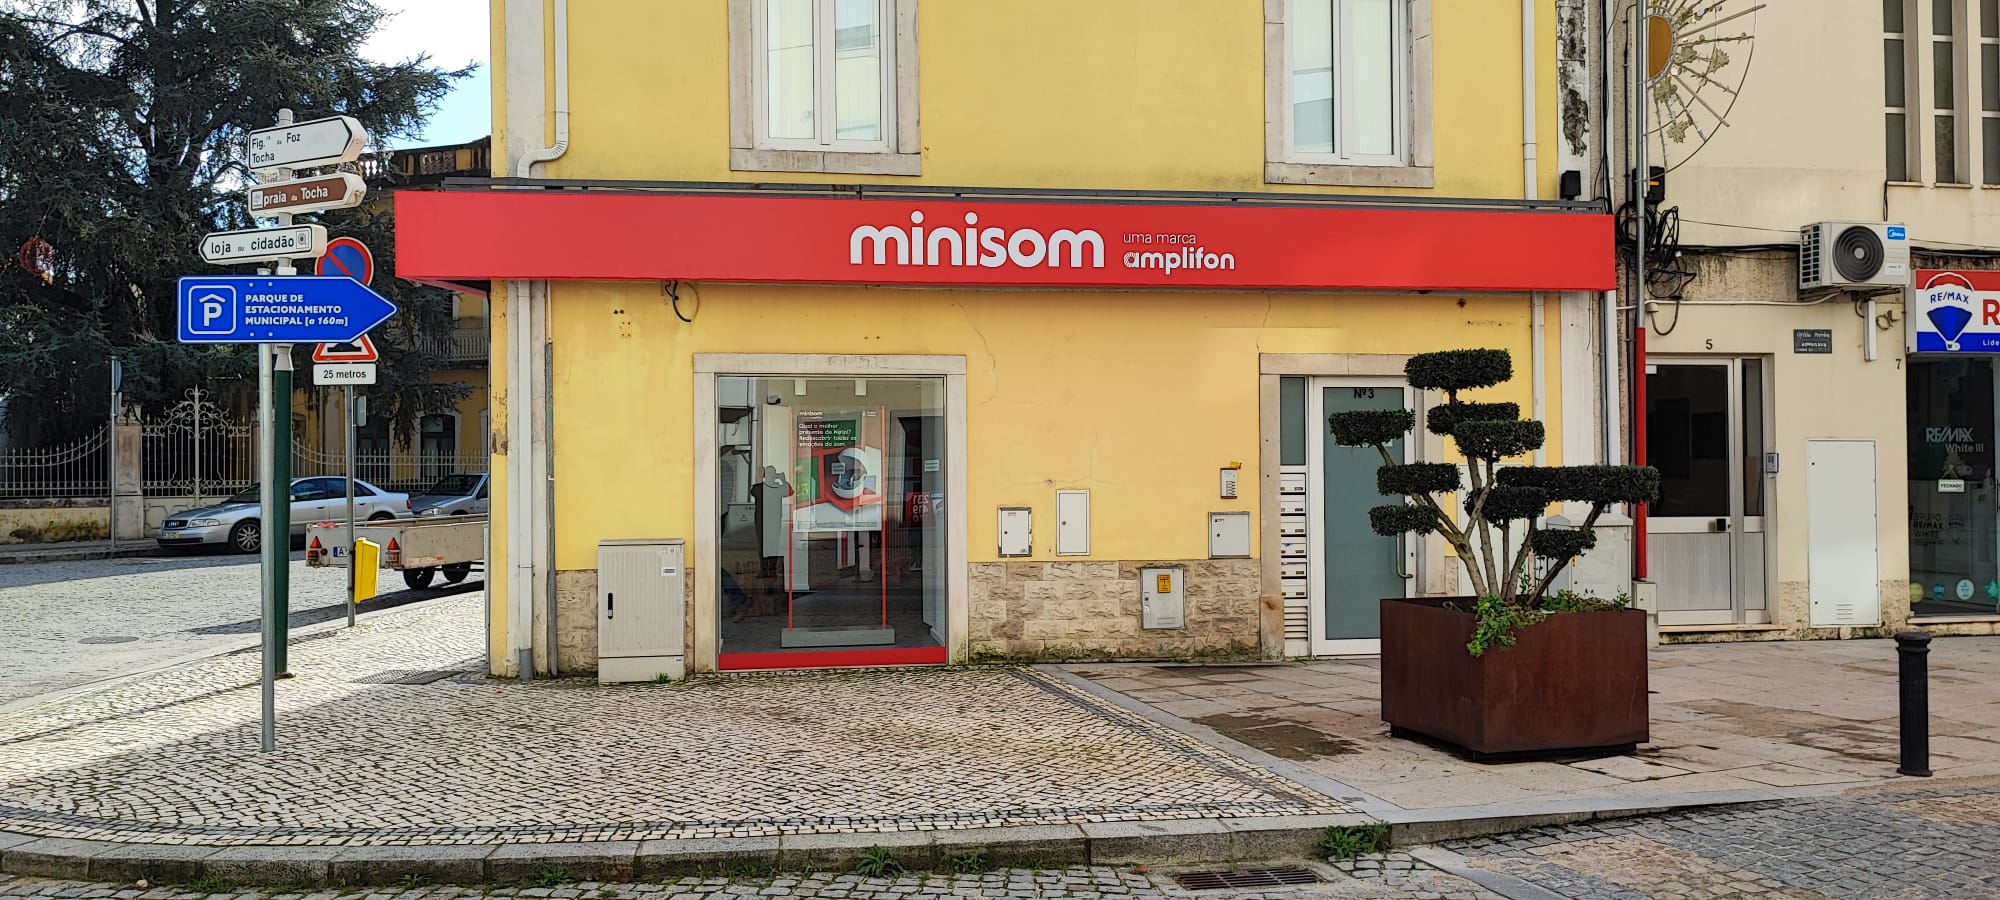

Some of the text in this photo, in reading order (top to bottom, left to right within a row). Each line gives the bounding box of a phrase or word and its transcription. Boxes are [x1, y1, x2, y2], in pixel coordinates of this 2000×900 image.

[286, 132, 301, 143] Foz
[252, 151, 275, 163] Tocha
[263, 191, 287, 207] praia
[300, 186, 328, 200] Tocha
[849, 210, 1105, 269] minisom
[1123, 233, 1196, 244] uma marca
[211, 241, 231, 256] loja
[250, 235, 295, 251] cidadão
[1123, 246, 1235, 275] amplifon
[245, 294, 304, 303] PARQUE DE
[1930, 291, 1969, 304] RE/MAX
[245, 305, 342, 314] ESTACIONAMENTO
[245, 317, 302, 325] MUNICIPAL
[317, 316, 348, 327] 160m]
[1705, 338, 1713, 350] 5
[1895, 358, 1902, 370] 7
[323, 369, 367, 379] 25 metros
[1925, 426, 1974, 443] RE/MAX
[1945, 443, 1974, 453] White
